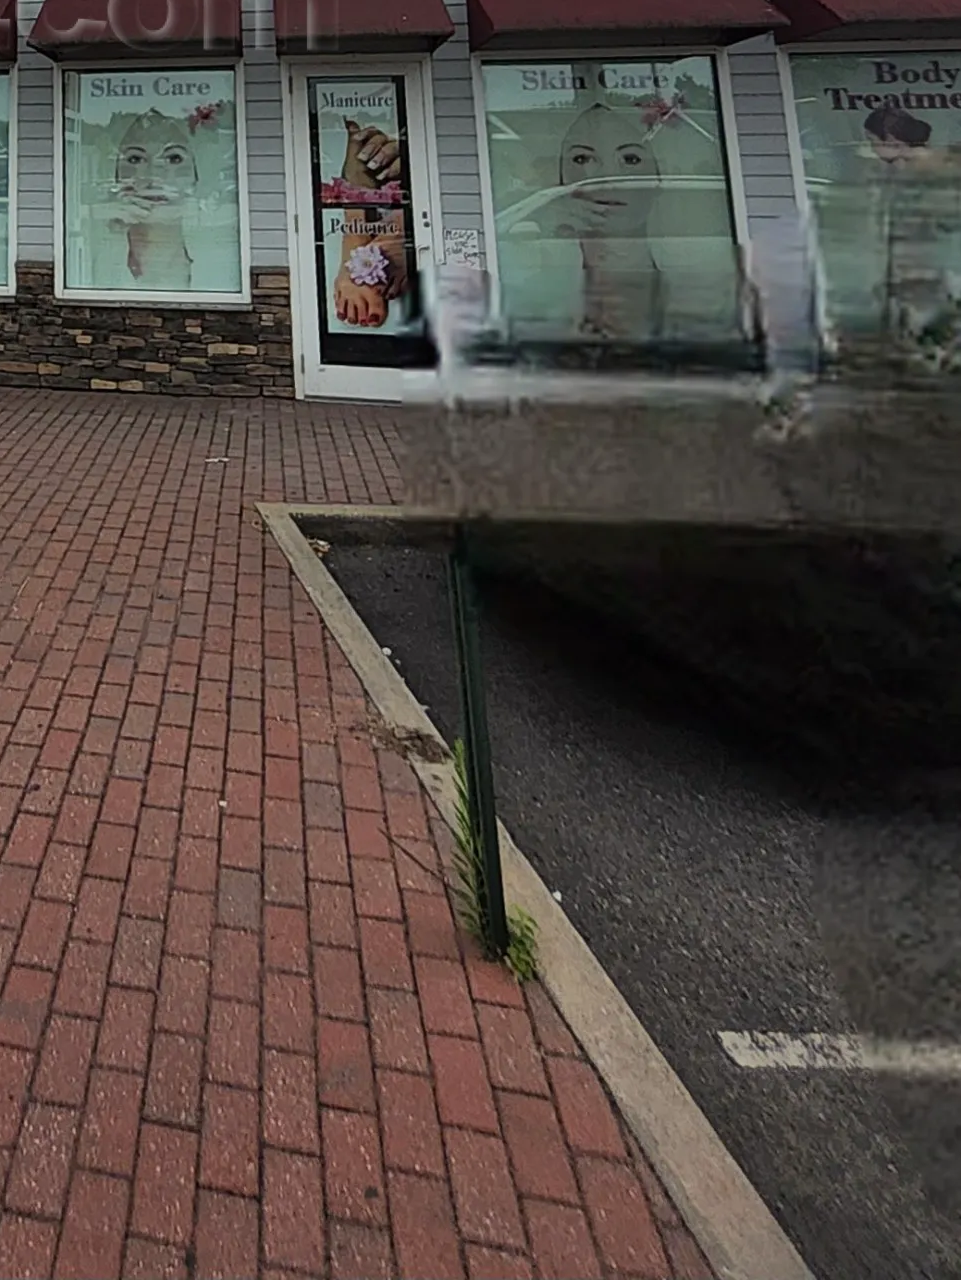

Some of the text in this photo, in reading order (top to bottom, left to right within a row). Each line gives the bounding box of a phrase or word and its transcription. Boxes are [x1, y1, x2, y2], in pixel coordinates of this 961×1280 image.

[522, 69, 669, 90] Skin Care
[871, 60, 960, 89] Body
[90, 77, 211, 98] Skin Care
[320, 91, 394, 109] Manicure
[326, 218, 399, 236] Pedicure
